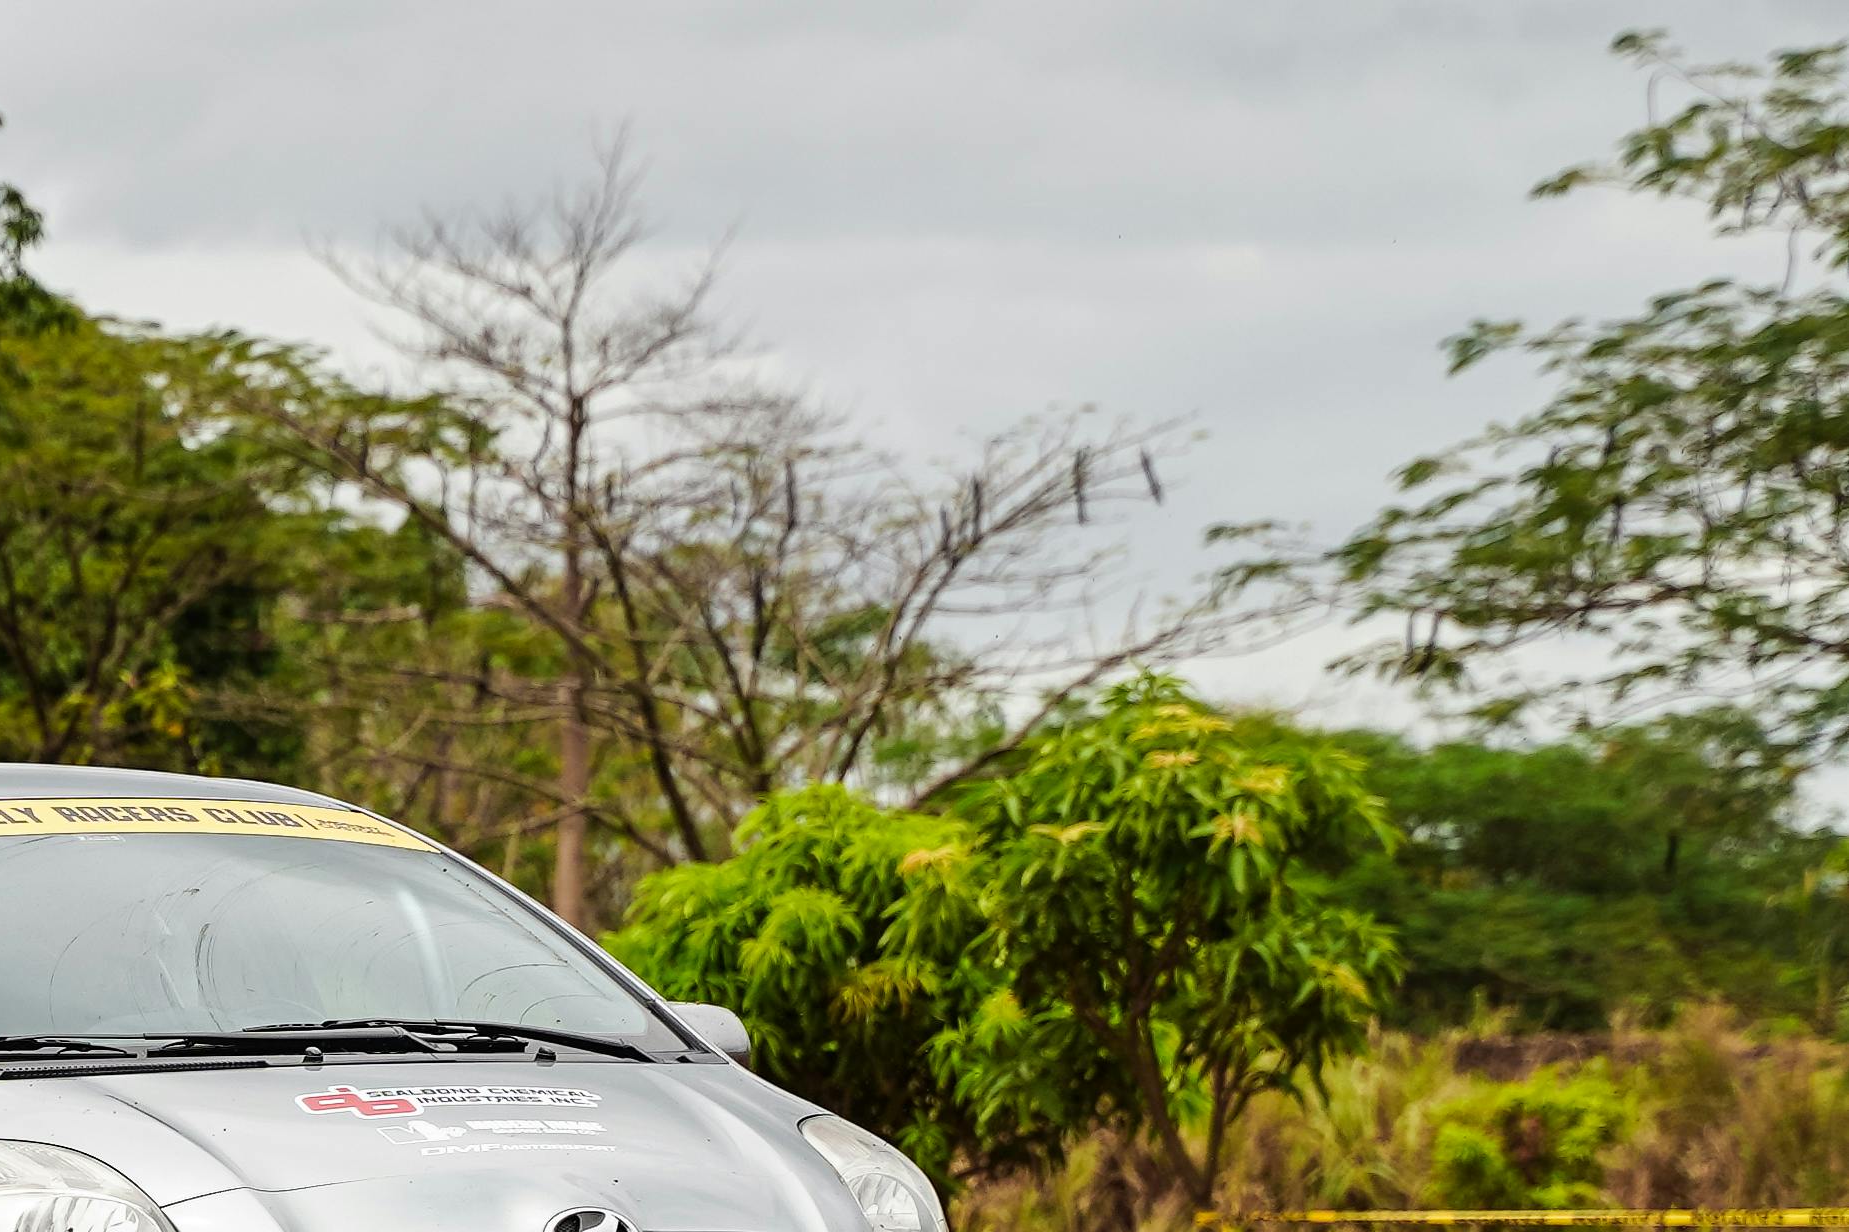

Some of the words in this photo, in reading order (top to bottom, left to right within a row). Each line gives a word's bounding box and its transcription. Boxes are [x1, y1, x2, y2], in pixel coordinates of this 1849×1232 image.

[51, 806, 199, 823] RACERS
[202, 808, 303, 828] CLUB
[488, 1087, 593, 1098] CHEMICAL
[416, 1095, 542, 1104] INDUSTRIES
